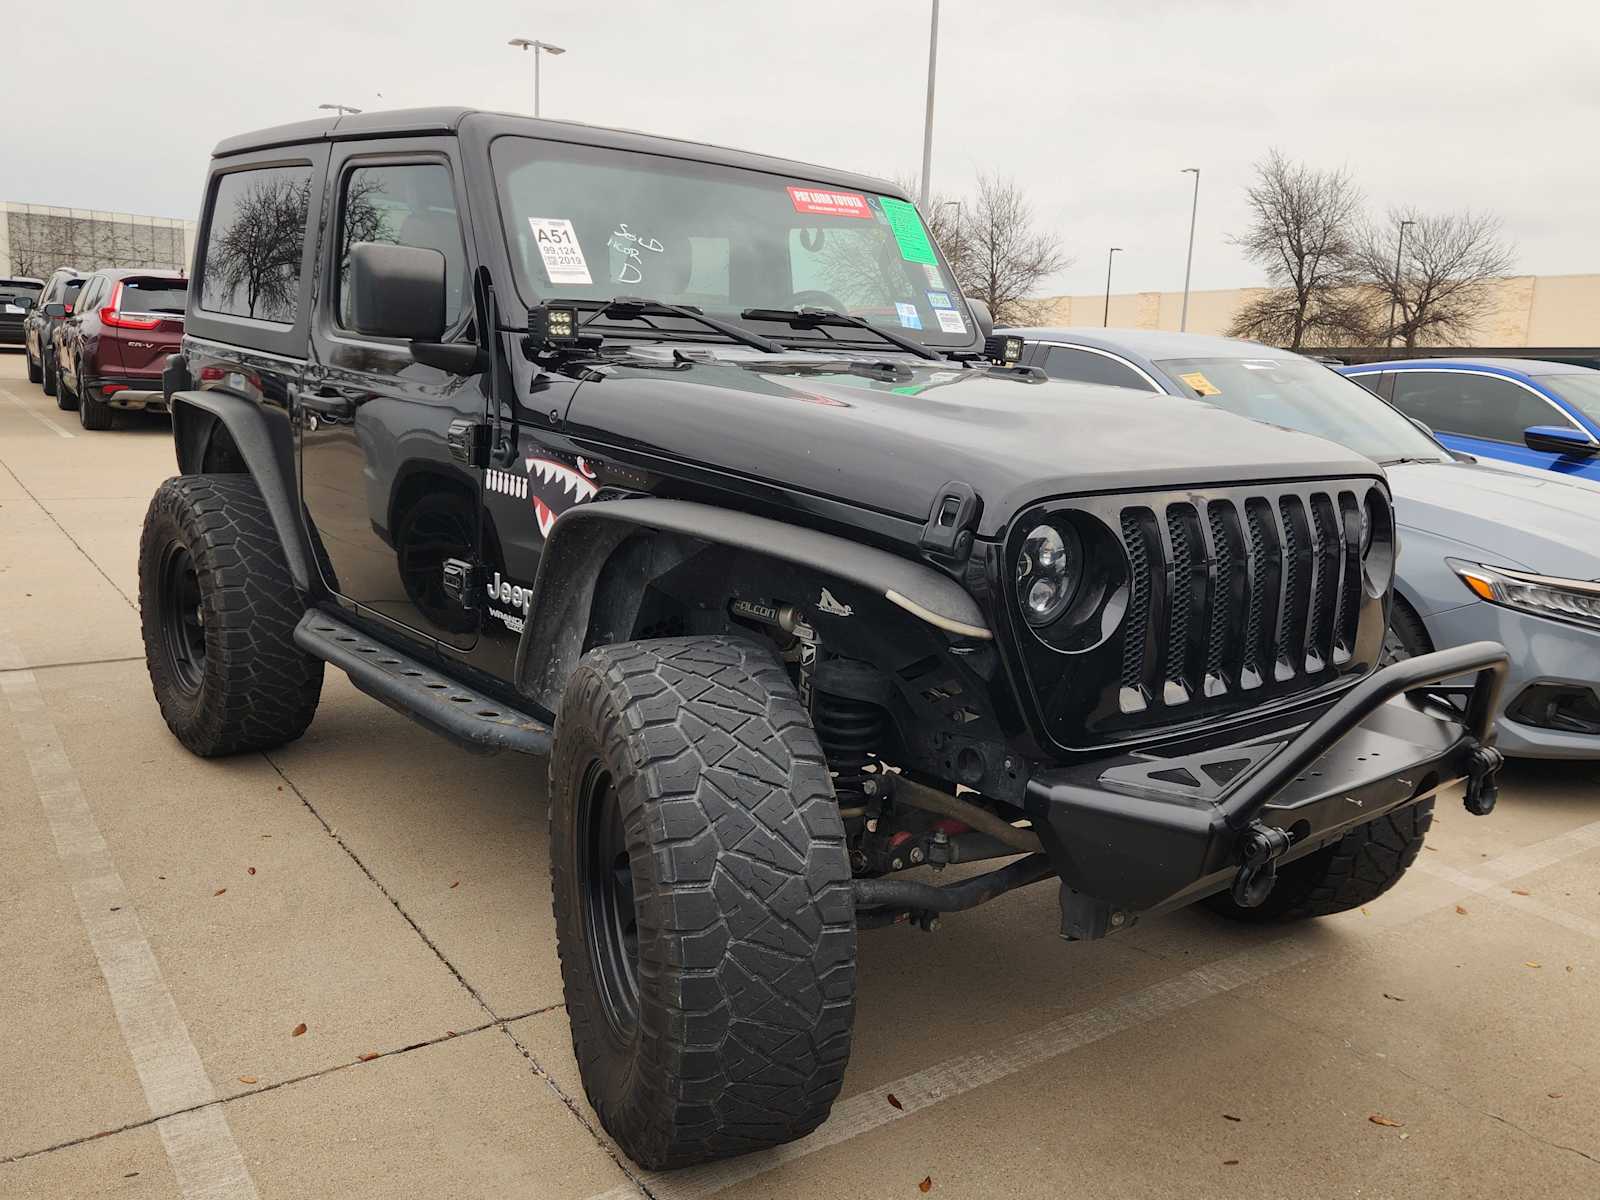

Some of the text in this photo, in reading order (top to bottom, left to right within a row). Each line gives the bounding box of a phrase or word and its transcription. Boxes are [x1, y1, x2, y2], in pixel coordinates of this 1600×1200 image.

[538, 228, 571, 245] A51
[559, 256, 582, 266] 2019
[486, 571, 533, 616] Jeep
